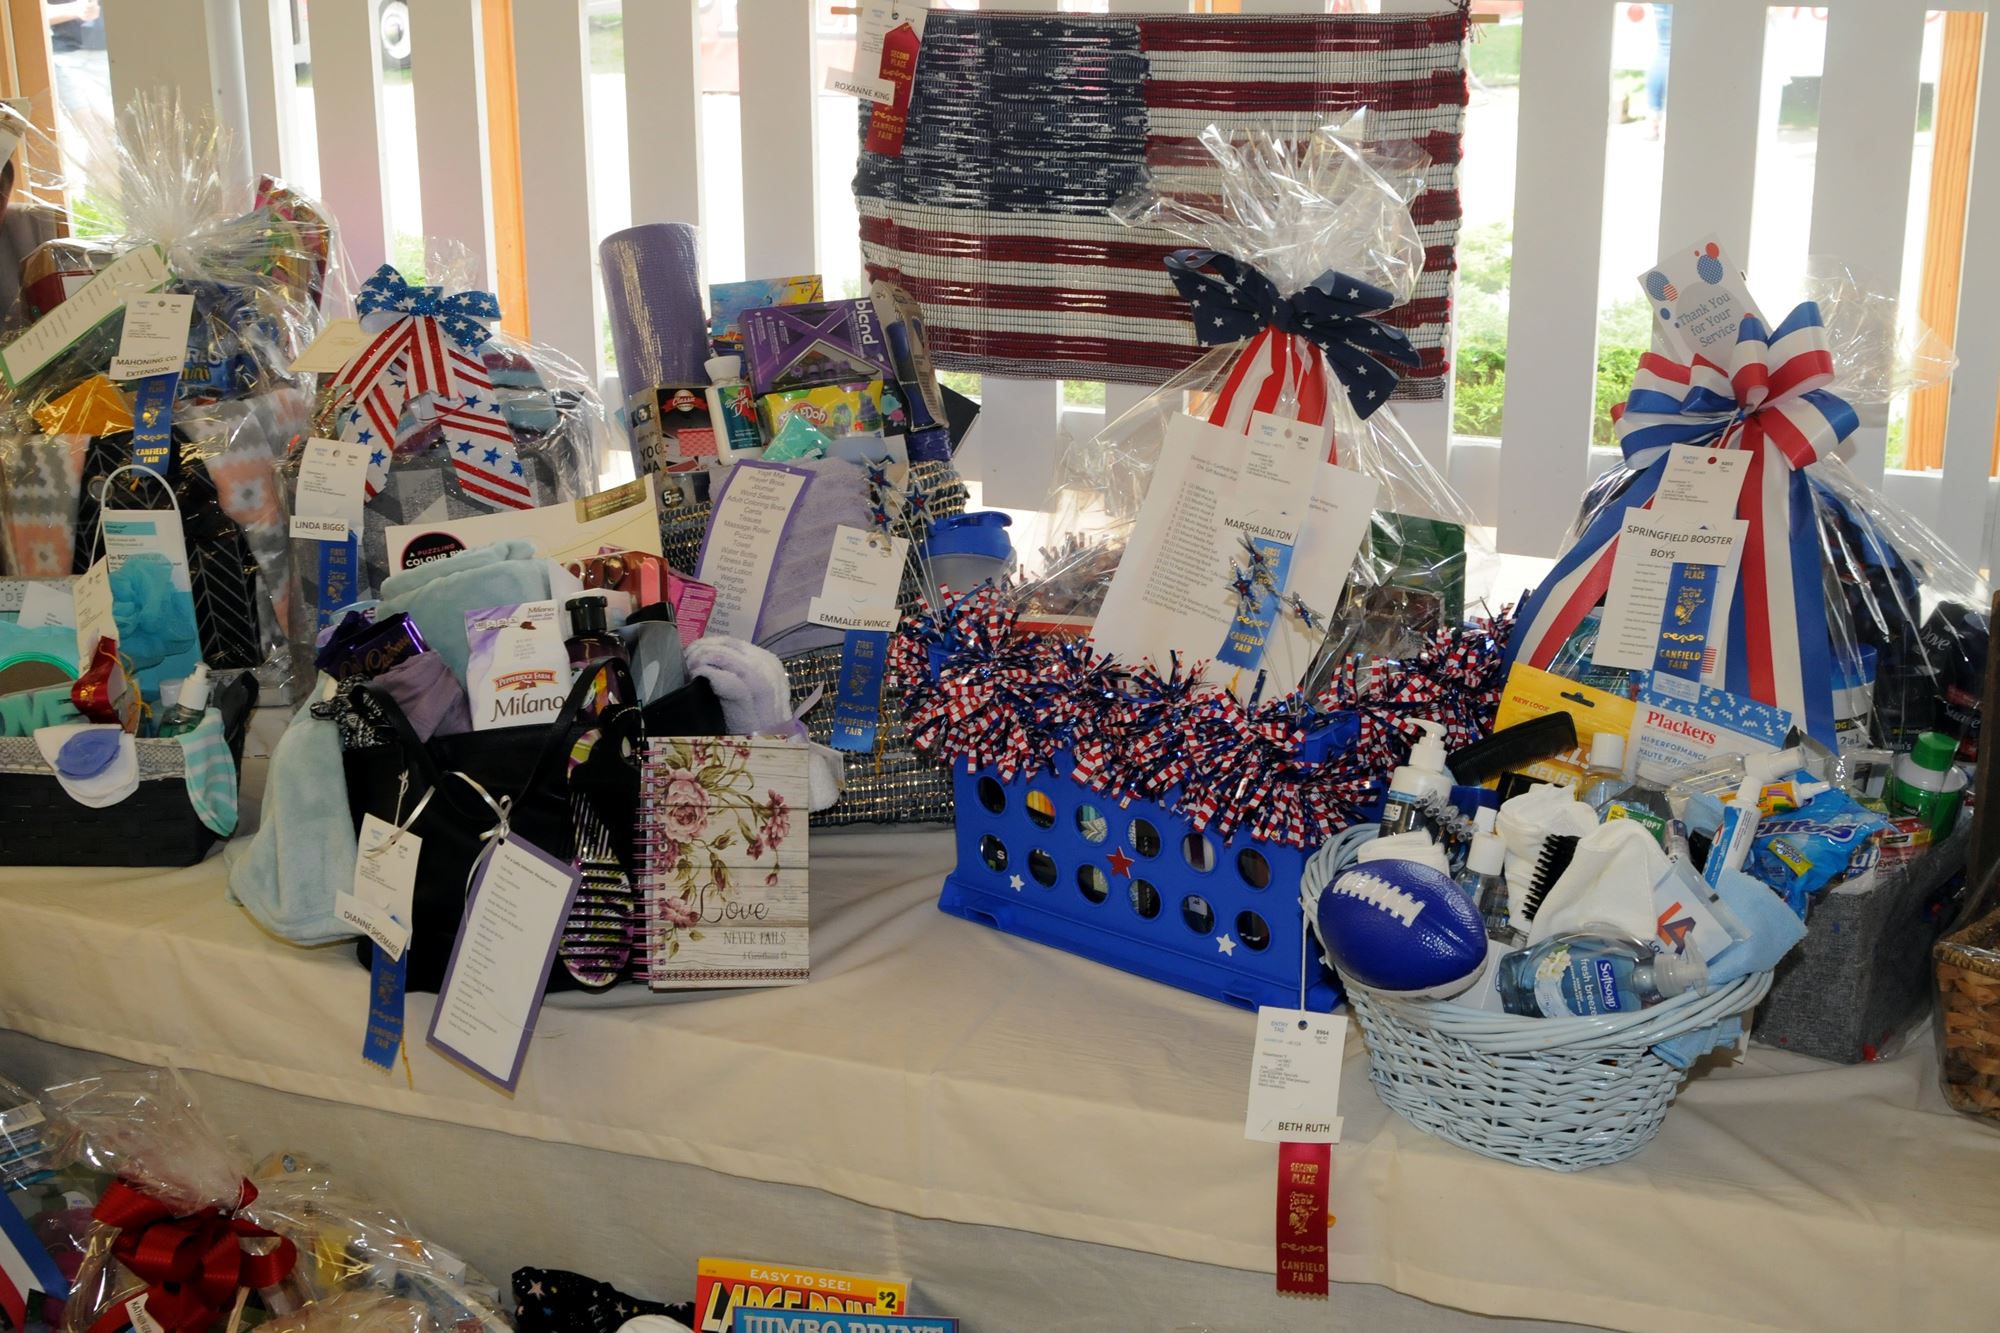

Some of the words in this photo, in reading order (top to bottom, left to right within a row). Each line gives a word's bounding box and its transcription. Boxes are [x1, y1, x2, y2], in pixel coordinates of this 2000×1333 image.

[834, 81, 873, 97] ROXANNE
[873, 90, 890, 101] KING
[872, 121, 903, 134] CANFIELD
[877, 131, 893, 141] FAIR
[1677, 303, 1709, 327] Thank
[1708, 292, 1731, 309] You
[1690, 322, 1705, 337] for
[1706, 308, 1733, 328] Your
[1700, 322, 1737, 348] Service
[116, 357, 164, 366] MAHONING
[125, 366, 170, 378] EXTENSION
[135, 447, 169, 456] CANFIELD
[143, 456, 160, 464] FAIR
[663, 490, 672, 505] 5
[295, 520, 321, 531] LINDA
[322, 522, 345, 532] BIGGS
[1224, 517, 1260, 534] MARSHA
[1261, 526, 1292, 541] DALTON
[1626, 524, 1689, 544] SPRINGFIELD
[1690, 534, 1733, 546] BOOSTER
[1649, 549, 1676, 560] BOYS
[1683, 570, 1706, 580] PLACE
[819, 613, 862, 627] EMMALEE
[863, 619, 892, 628] WINCE
[1231, 631, 1264, 646] CANFIELD
[1234, 642, 1252, 654] FAIR
[1660, 649, 1701, 661] CANFIELD
[1667, 660, 1689, 670] FAIR
[490, 692, 566, 723] Milano
[1512, 695, 1528, 706] NEW
[1529, 701, 1551, 713] LOOK
[837, 715, 873, 729] CANFIELD
[1646, 710, 1717, 745] Plackers
[844, 726, 863, 737] FAIR
[1639, 747, 1663, 761] HAUTE
[1527, 765, 1579, 785] RELIEF
[1642, 819, 1662, 830] SOFT
[697, 882, 770, 924] Love
[343, 911, 373, 932] DIANNE
[723, 931, 757, 945] NEVER
[760, 931, 787, 946] FAILS
[1580, 958, 1590, 983] fresh
[1599, 962, 1616, 1008] Softsoap
[1584, 984, 1598, 1017] breeze
[1278, 1121, 1302, 1132] BETH
[1305, 1123, 1331, 1133] RUTH
[1290, 1162, 1319, 1174] SECOND
[1291, 1173, 1316, 1185] PLACE
[1281, 1260, 1325, 1273] CANFIELD
[750, 1268, 791, 1283] EASY
[793, 1274, 814, 1287] TO
[818, 1277, 852, 1292] SEE!
[1292, 1272, 1314, 1282] FAIR
[878, 1291, 897, 1310] $2
